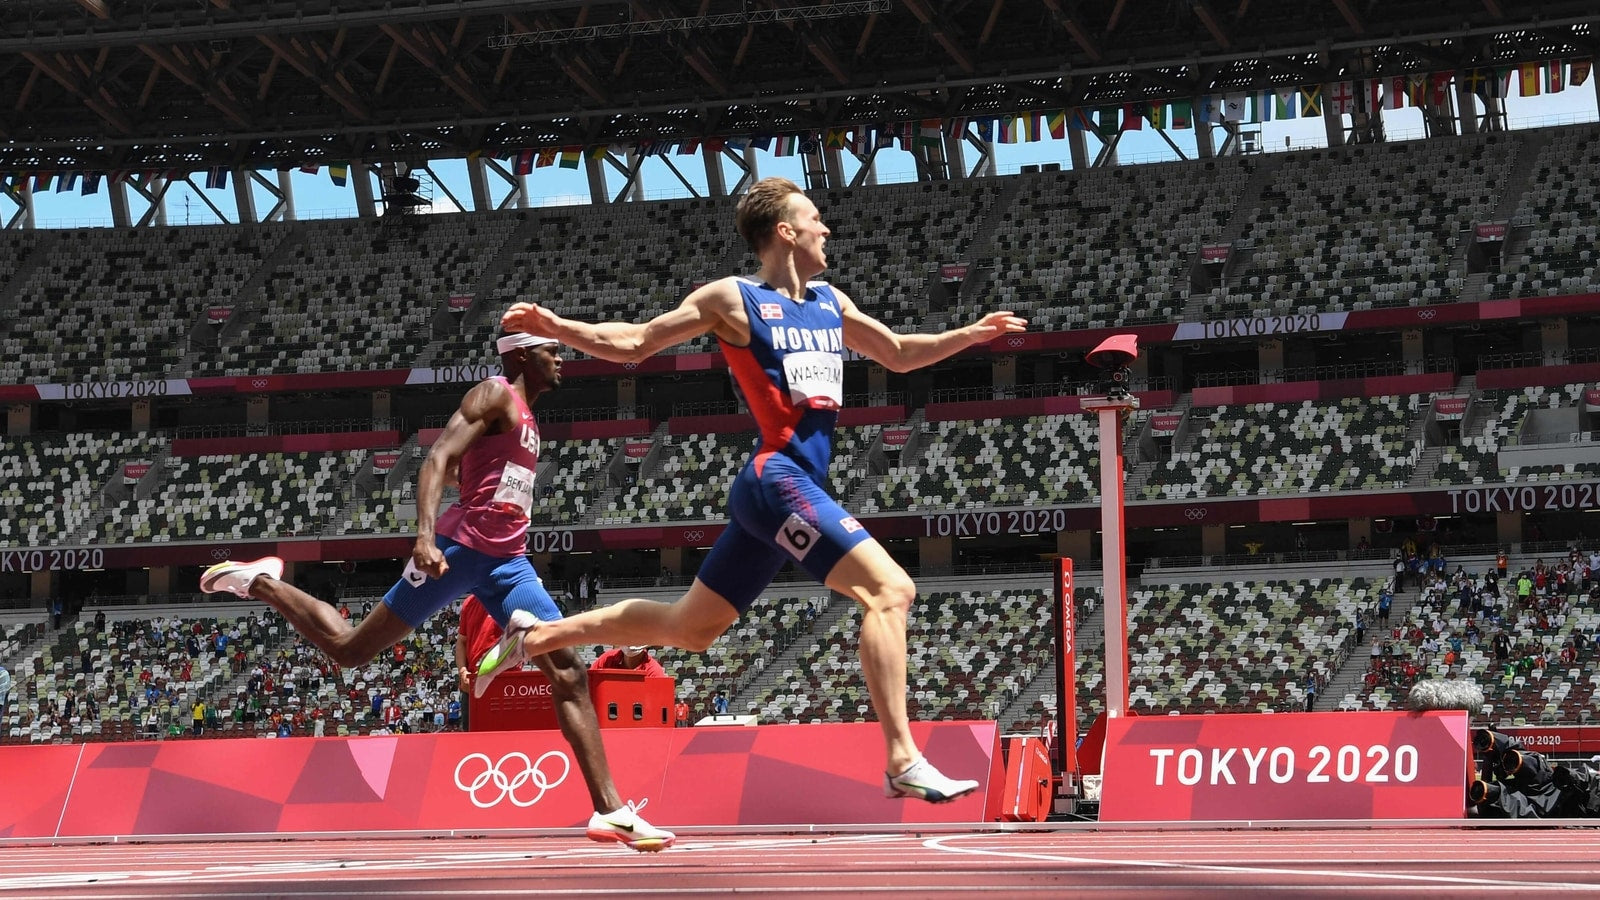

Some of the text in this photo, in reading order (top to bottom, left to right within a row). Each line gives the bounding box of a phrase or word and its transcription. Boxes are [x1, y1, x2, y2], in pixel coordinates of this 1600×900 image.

[1202, 314, 1320, 340] TOKYO 2020
[431, 364, 488, 383] TOKYO
[63, 378, 169, 399] TOKYO 2020
[1448, 486, 1536, 513] TOKYO
[921, 509, 1066, 537] TOKYO 2020
[784, 526, 811, 550] 6
[1, 548, 105, 573] KYO 2020
[1064, 593, 1073, 654] OMEGA
[518, 684, 553, 697] OMEG
[1537, 735, 1561, 746] 2020
[1149, 743, 1420, 786] TOKYO 2020
